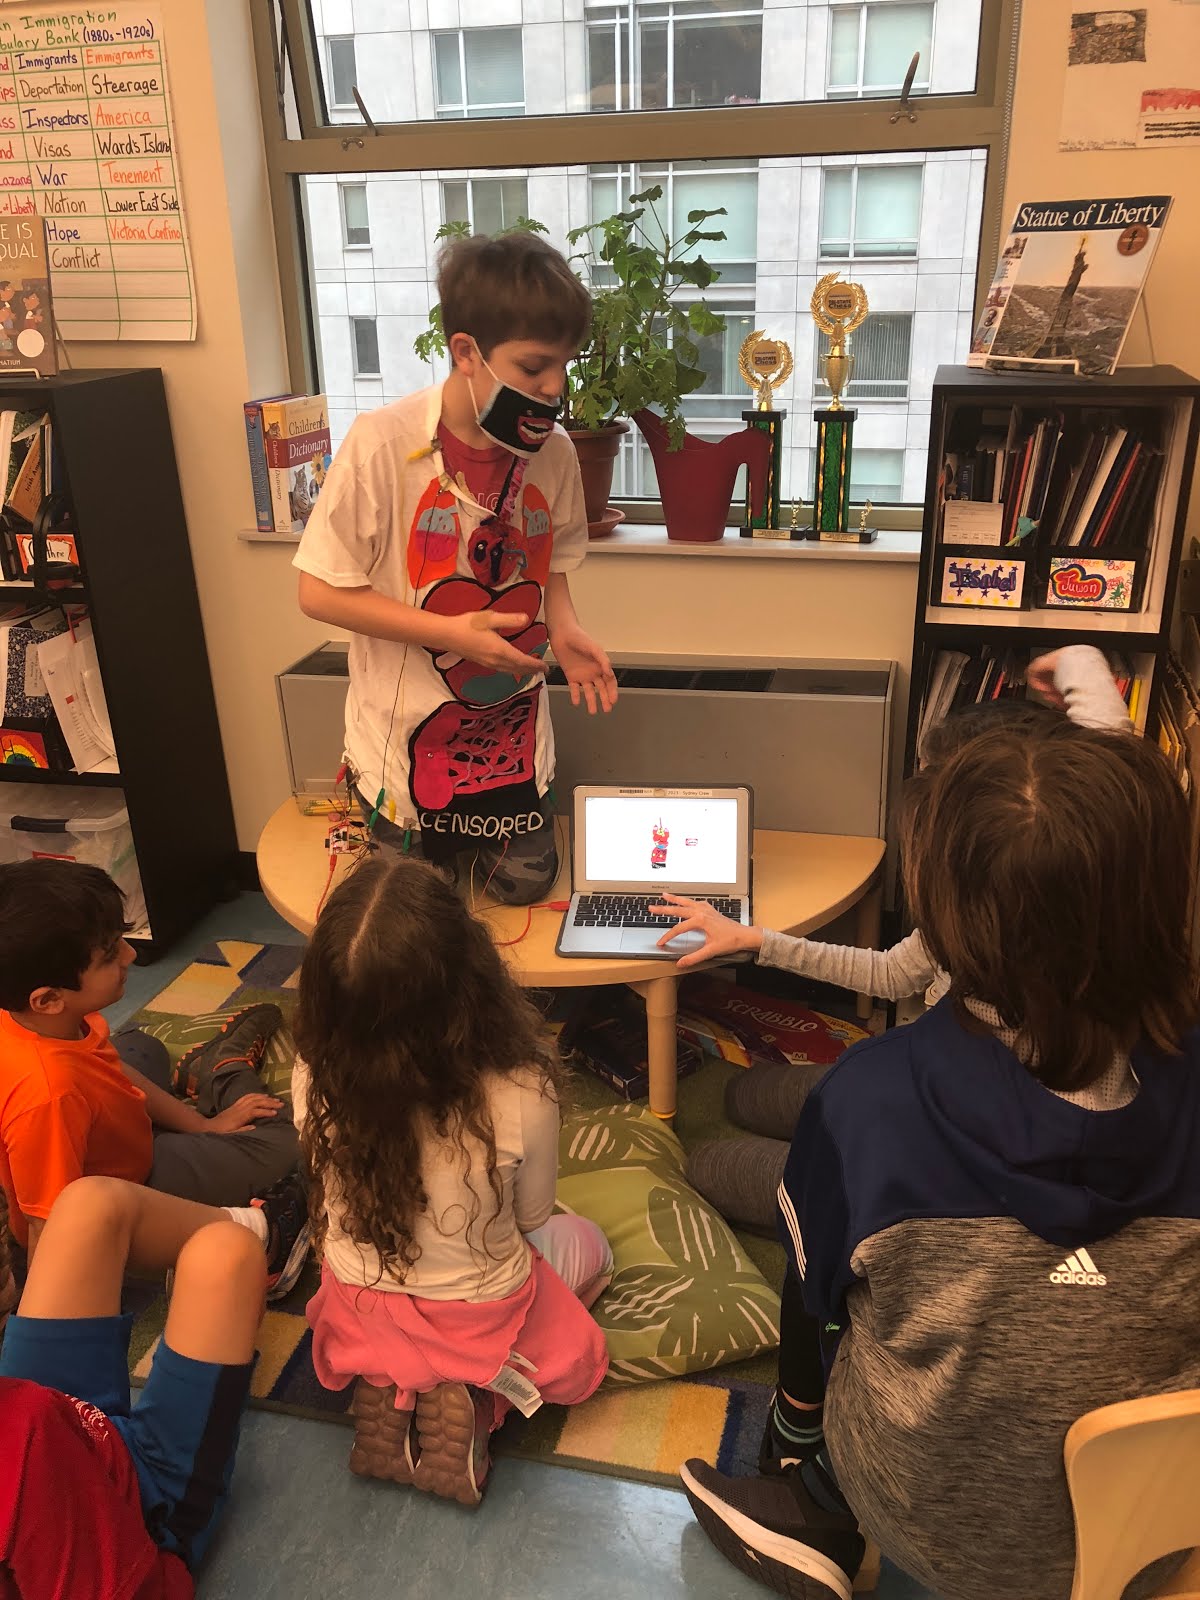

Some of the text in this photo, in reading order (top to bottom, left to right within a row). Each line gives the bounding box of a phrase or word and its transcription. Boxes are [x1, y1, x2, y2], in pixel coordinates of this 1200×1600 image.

[20, 10, 117, 30] Immigration
[46, 29, 80, 46] Bank
[15, 50, 78, 69] Immigrants
[86, 44, 155, 65] Emmigrants
[19, 76, 85, 100] Deportation
[91, 73, 159, 95] Steerage
[22, 108, 89, 130] Inspectors
[95, 104, 152, 126] America
[33, 136, 72, 158] Visas
[96, 132, 172, 155] Ward's Island
[36, 163, 68, 187] War
[102, 160, 163, 184] Tenement
[44, 191, 87, 214] Nation
[104, 191, 180, 213] Lower East Side
[1016, 202, 1165, 228] Statue of Liberty
[17, 222, 33, 239] IS
[45, 220, 81, 243] Hope
[108, 218, 182, 241] Victoria Confino
[52, 246, 101, 268] Conflict
[288, 418, 326, 436] Children's
[289, 438, 329, 460] Dictionary
[274, 469, 282, 501] Dictionary
[420, 811, 544, 840] CENSORED
[721, 999, 819, 1032] SCRABBLE
[1049, 1270, 1107, 1286] adidas
